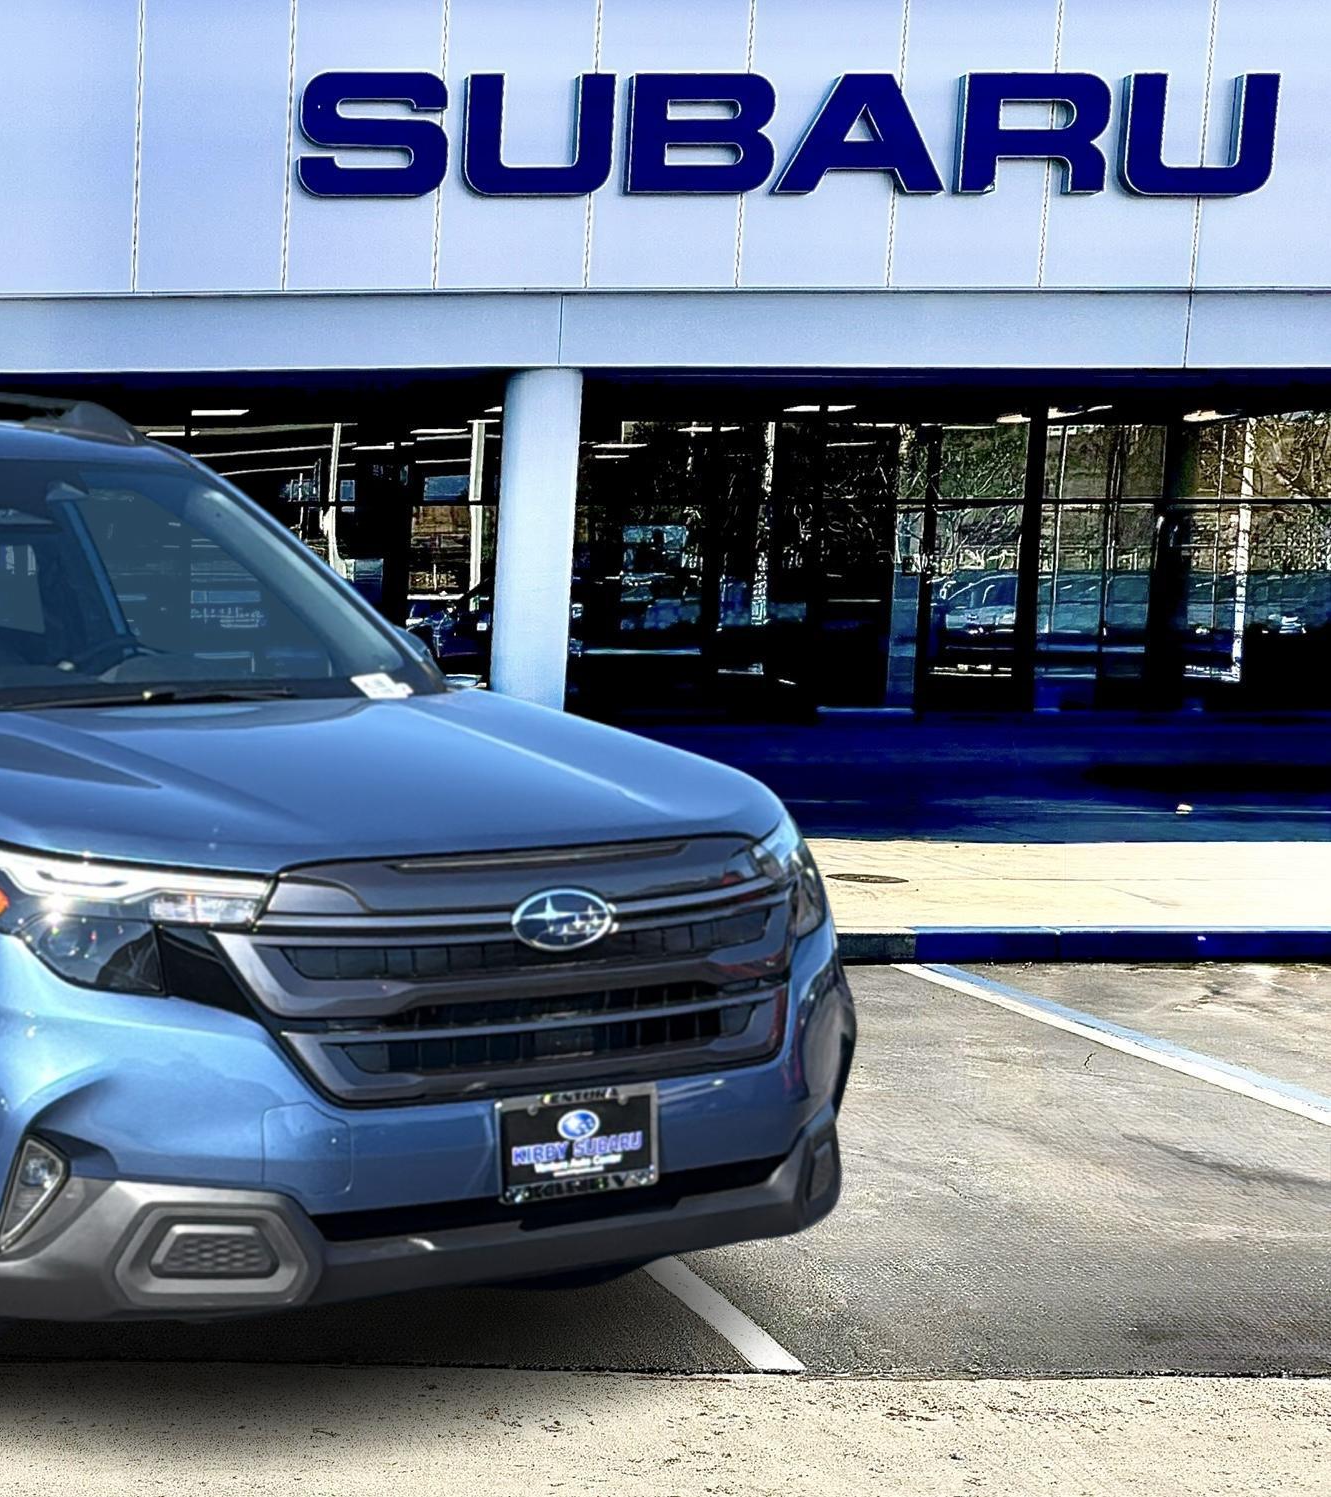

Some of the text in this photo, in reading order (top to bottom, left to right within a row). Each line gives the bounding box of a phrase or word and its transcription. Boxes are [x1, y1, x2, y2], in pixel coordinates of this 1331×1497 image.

[297, 71, 1282, 198] SUBARU
[512, 1131, 643, 1166] KIRBY SUBARU
